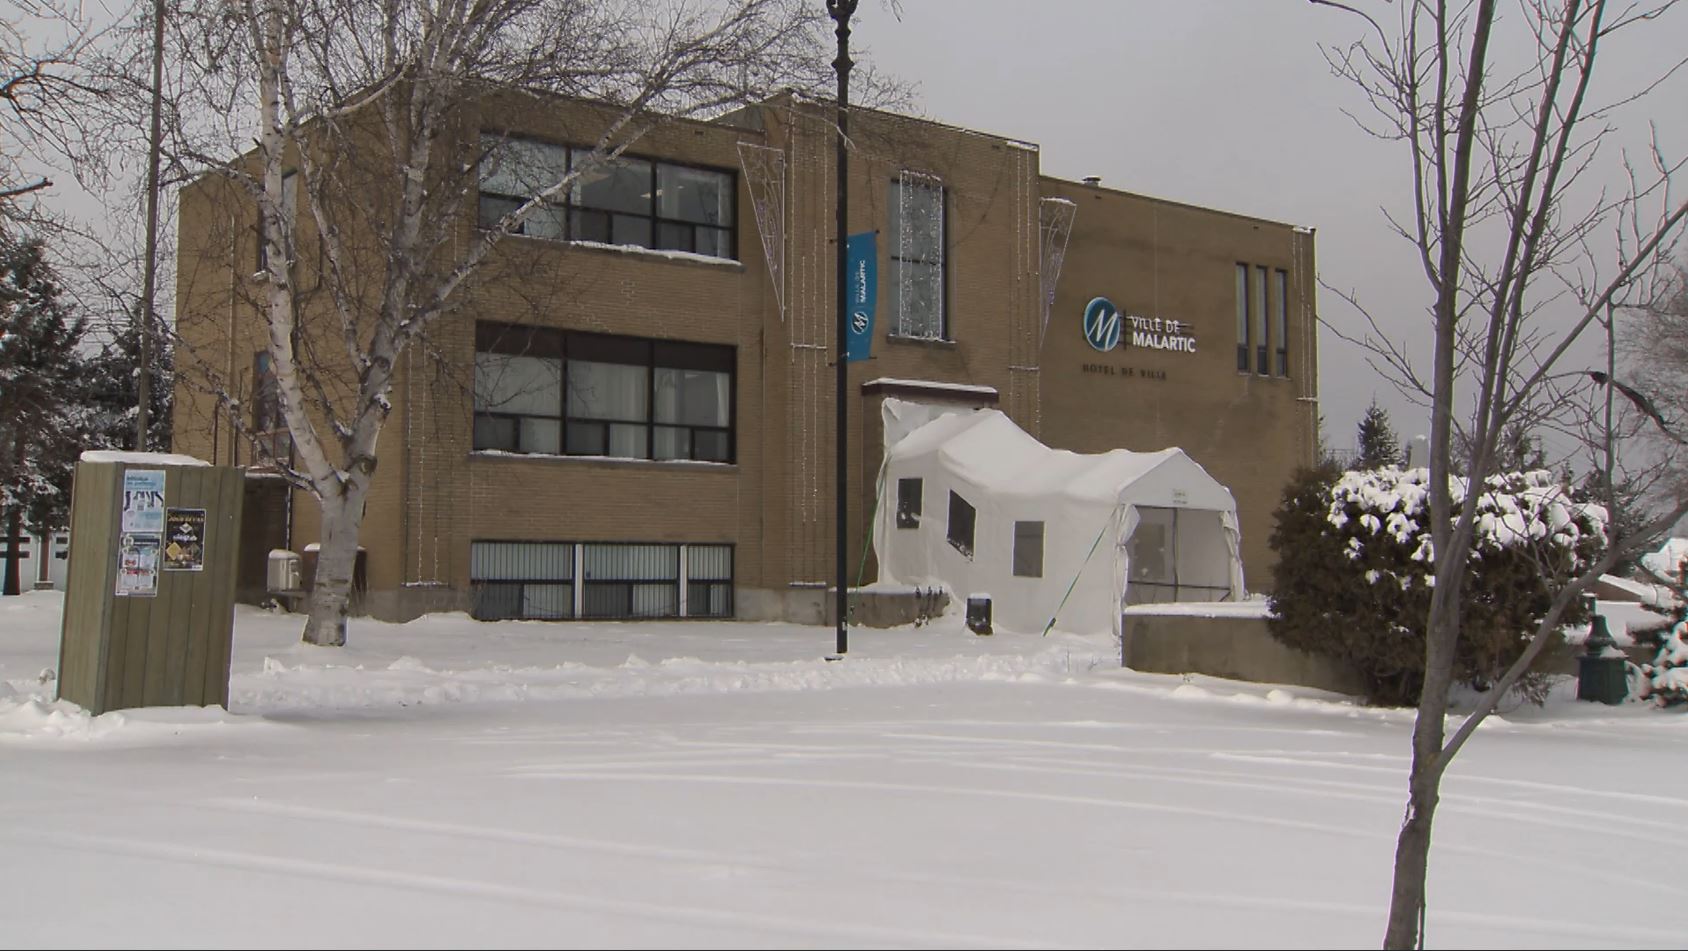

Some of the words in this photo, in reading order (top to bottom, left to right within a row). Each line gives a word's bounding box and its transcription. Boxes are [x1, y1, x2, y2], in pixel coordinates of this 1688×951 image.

[1131, 316, 1162, 332] VILLE
[1165, 319, 1181, 334] DE
[1132, 331, 1196, 353] MALARTIC
[1121, 367, 1134, 377] DE
[1140, 369, 1167, 380] VILLE
